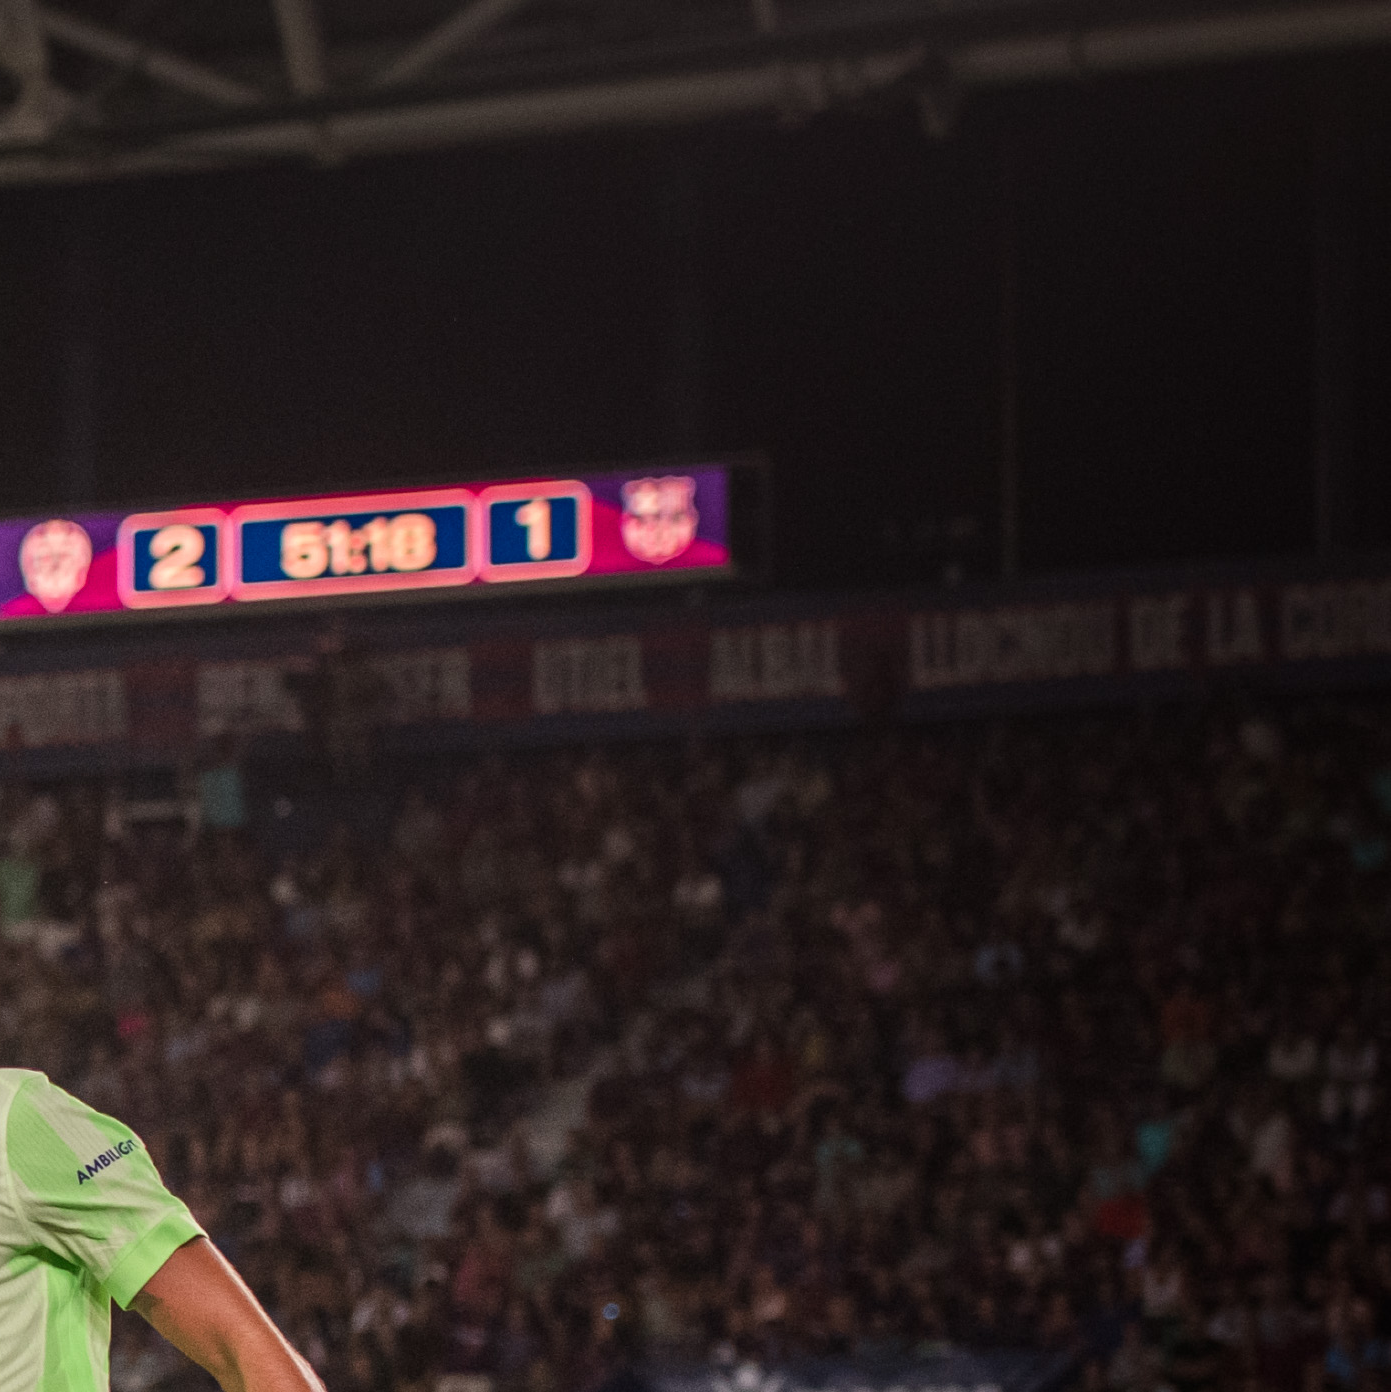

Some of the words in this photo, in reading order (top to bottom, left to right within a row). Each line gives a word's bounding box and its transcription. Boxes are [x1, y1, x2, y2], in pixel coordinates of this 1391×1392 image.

[148, 523, 206, 591] 2
[515, 496, 552, 561] 1
[77, 1139, 138, 1185] AMBILIG
